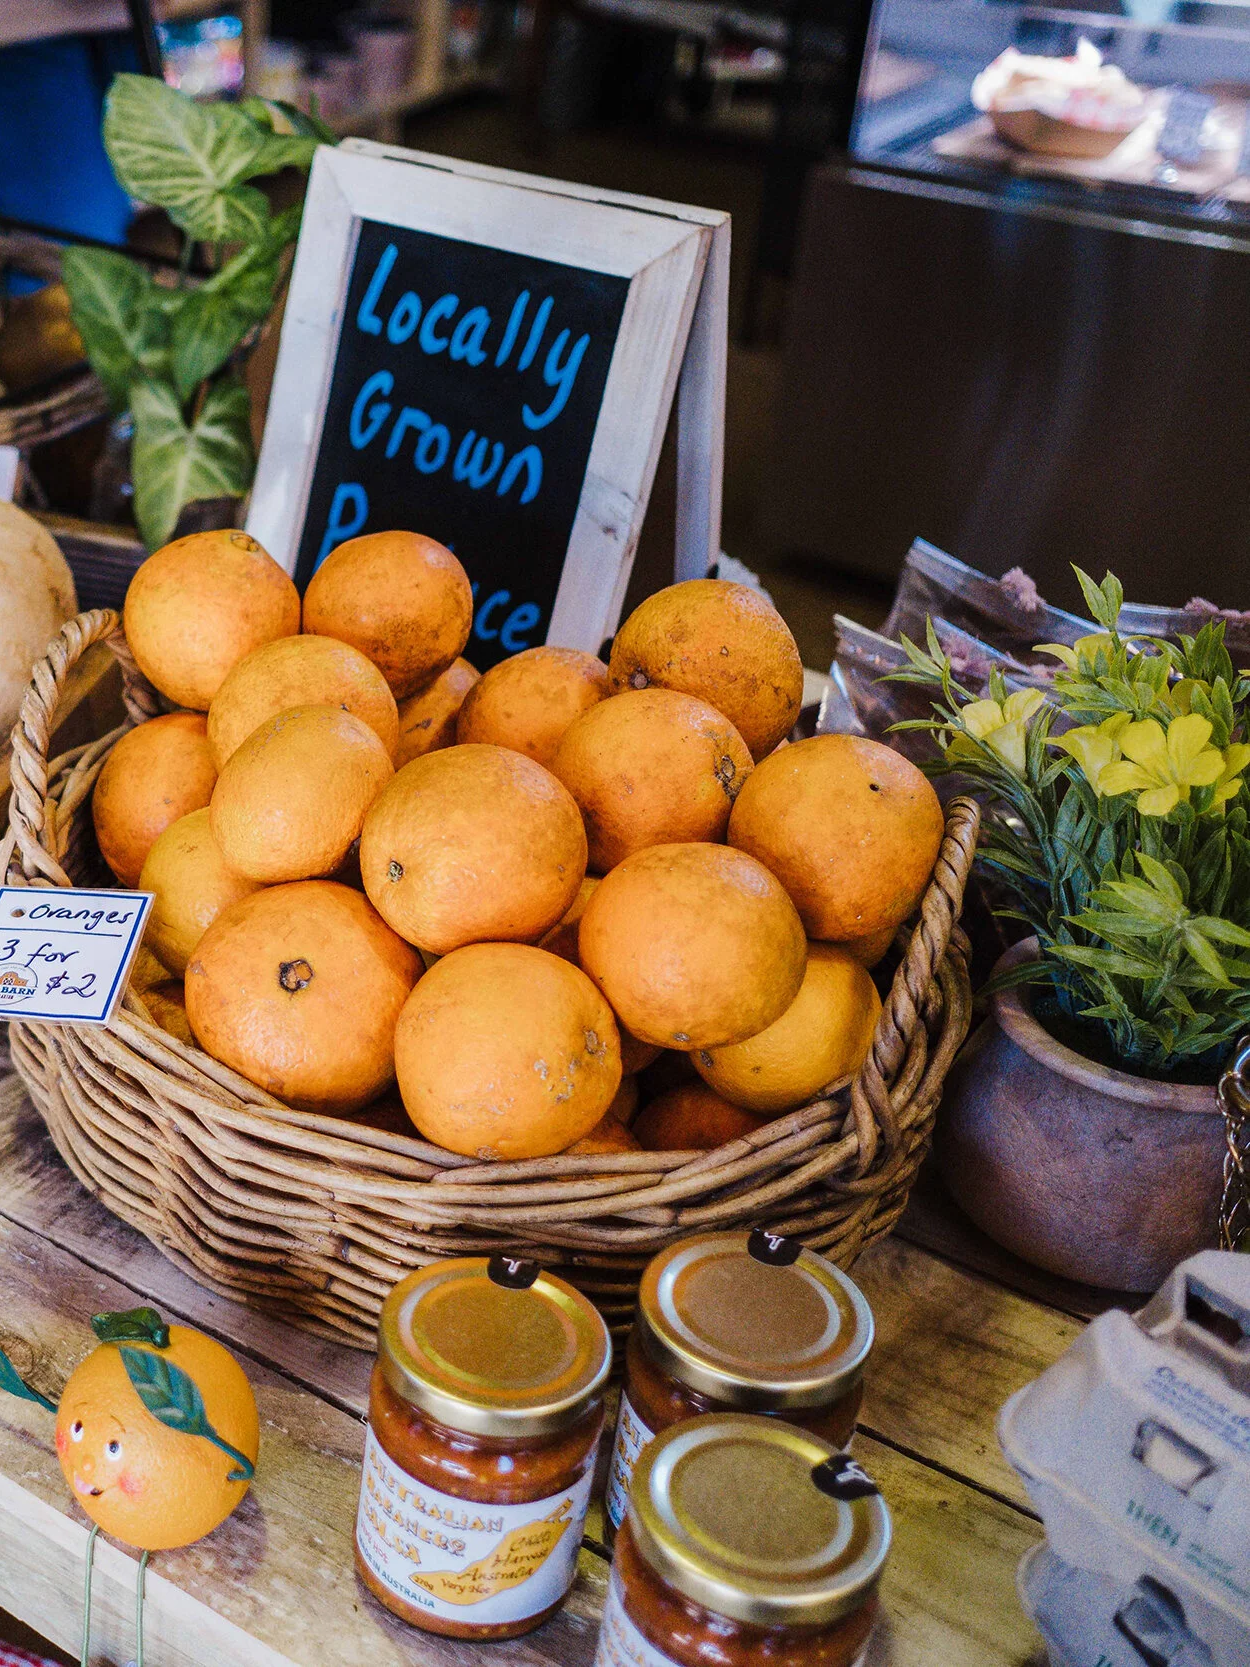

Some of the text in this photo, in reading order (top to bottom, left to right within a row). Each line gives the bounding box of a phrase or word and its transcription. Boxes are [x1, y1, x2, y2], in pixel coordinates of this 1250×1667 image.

[355, 243, 591, 431] Locally
[349, 369, 544, 505] Grown
[28, 903, 134, 931] Oranges
[23, 942, 80, 968] for
[0, 986, 37, 996] BARN
[45, 970, 97, 998] $2
[381, 1570, 436, 1609] AUSTRALIA
